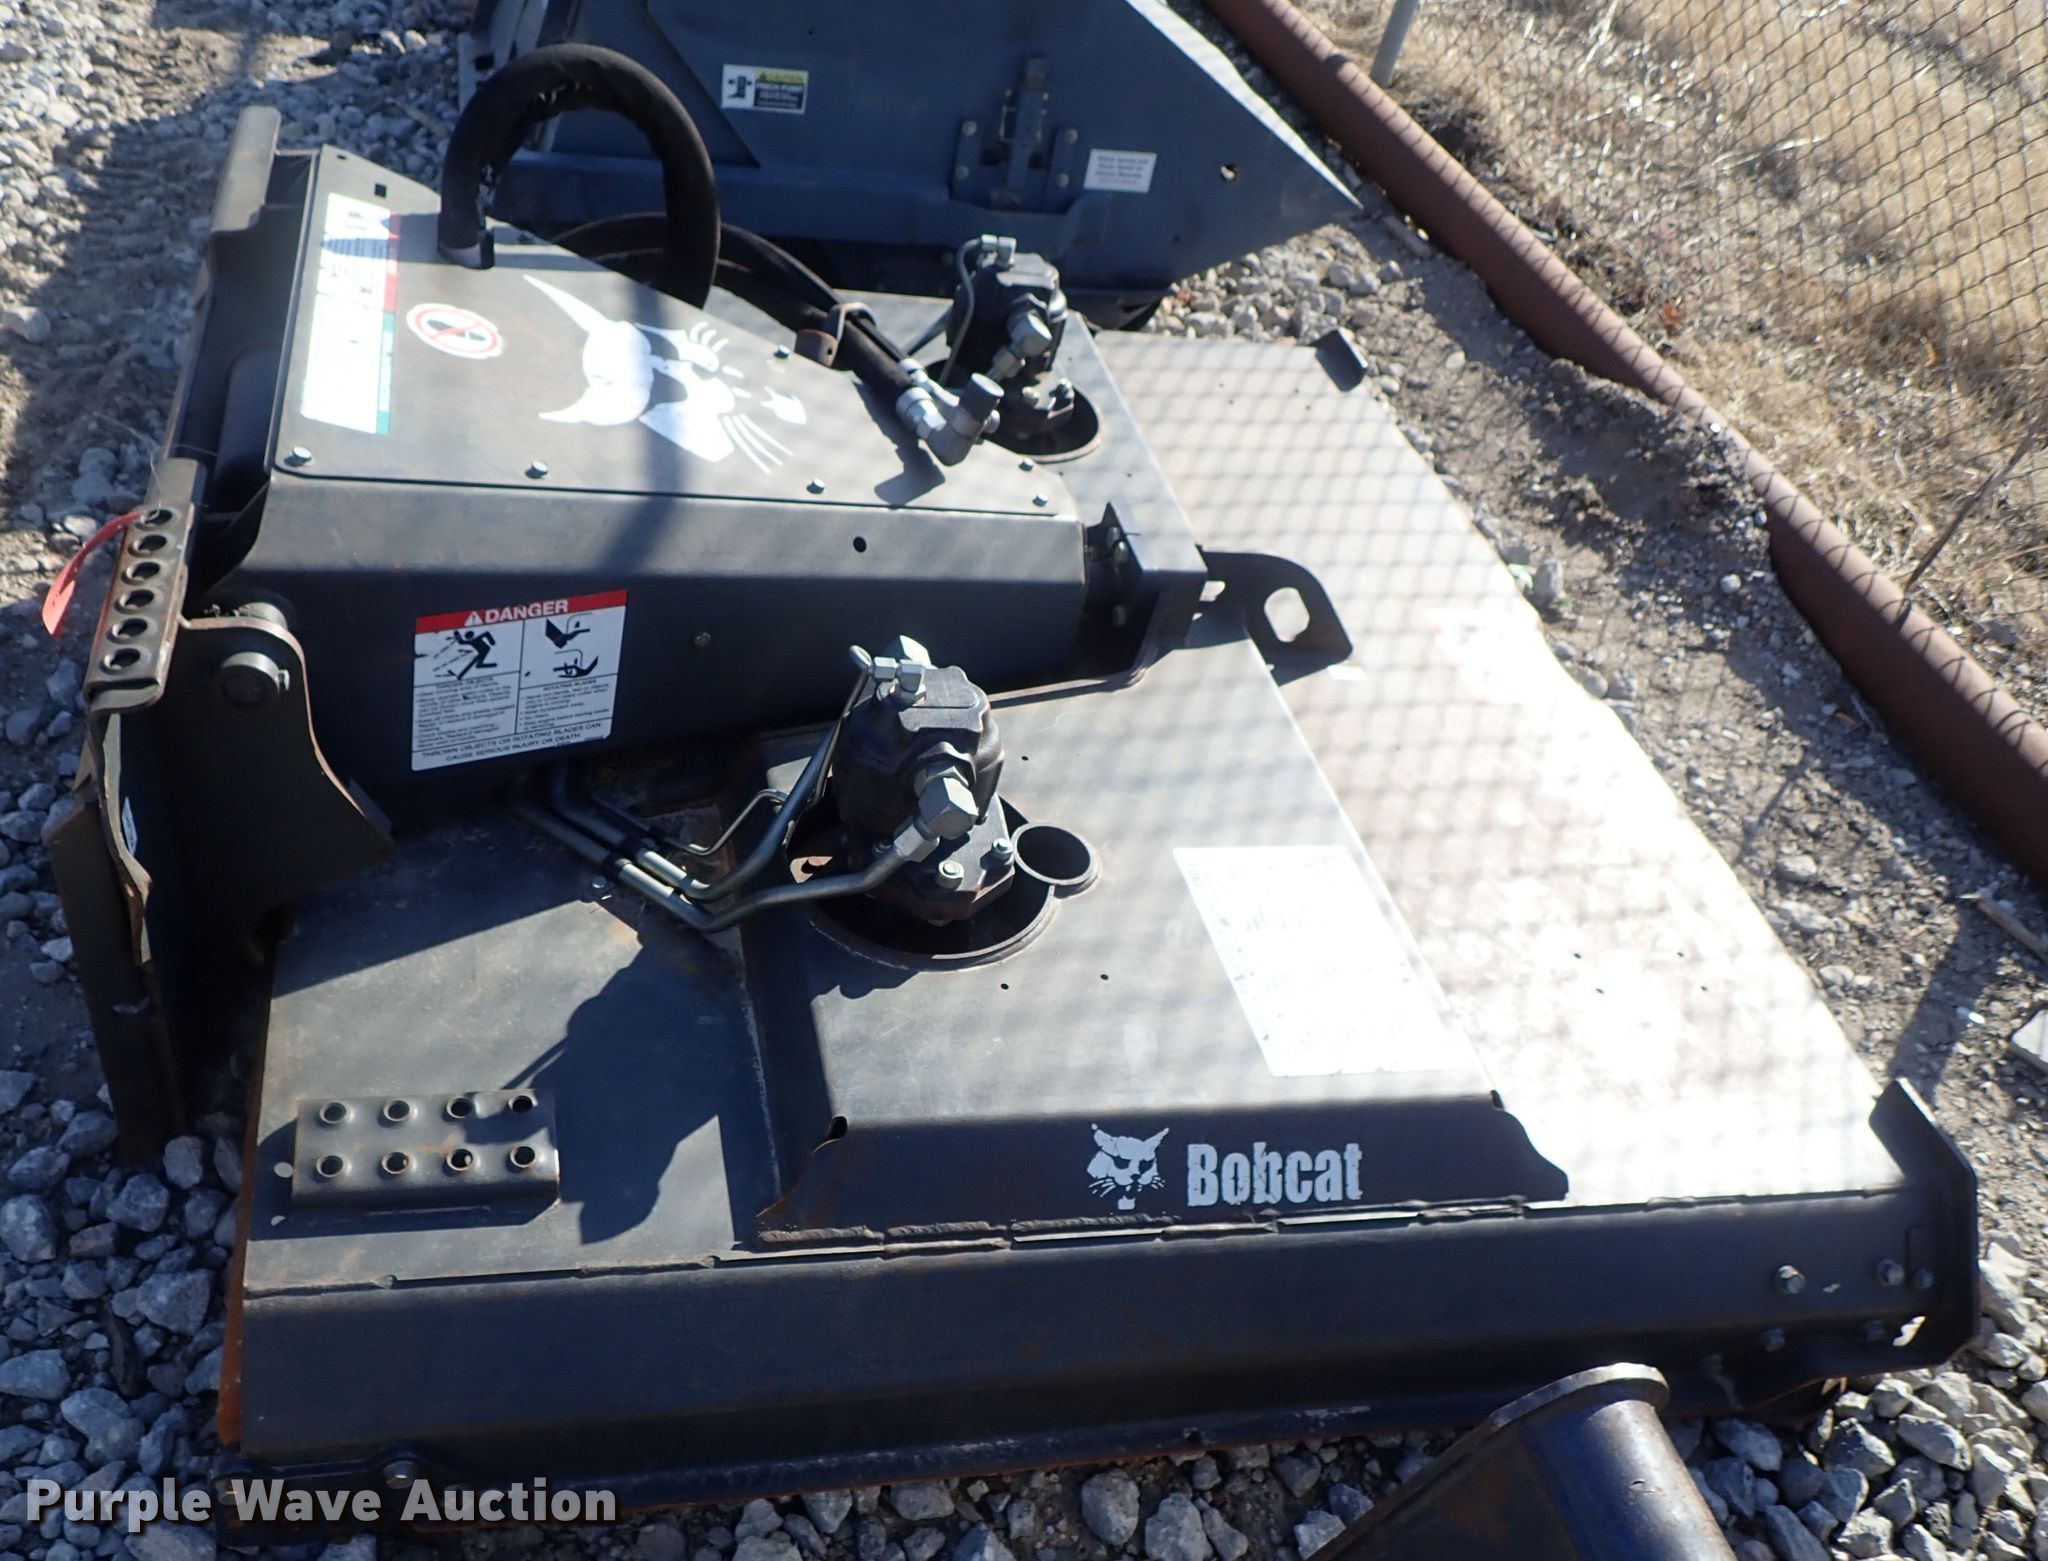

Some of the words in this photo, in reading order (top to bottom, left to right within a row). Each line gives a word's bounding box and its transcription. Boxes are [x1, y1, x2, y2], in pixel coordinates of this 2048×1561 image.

[484, 599, 569, 624] DANGER
[512, 730, 552, 742] ROTATING
[553, 725, 584, 735] BLADES
[585, 721, 601, 730] CAN
[512, 740, 539, 750] INJURY
[541, 737, 553, 745] OR
[554, 733, 580, 743] DEATH
[1187, 1141, 1363, 1207] Bobcat
